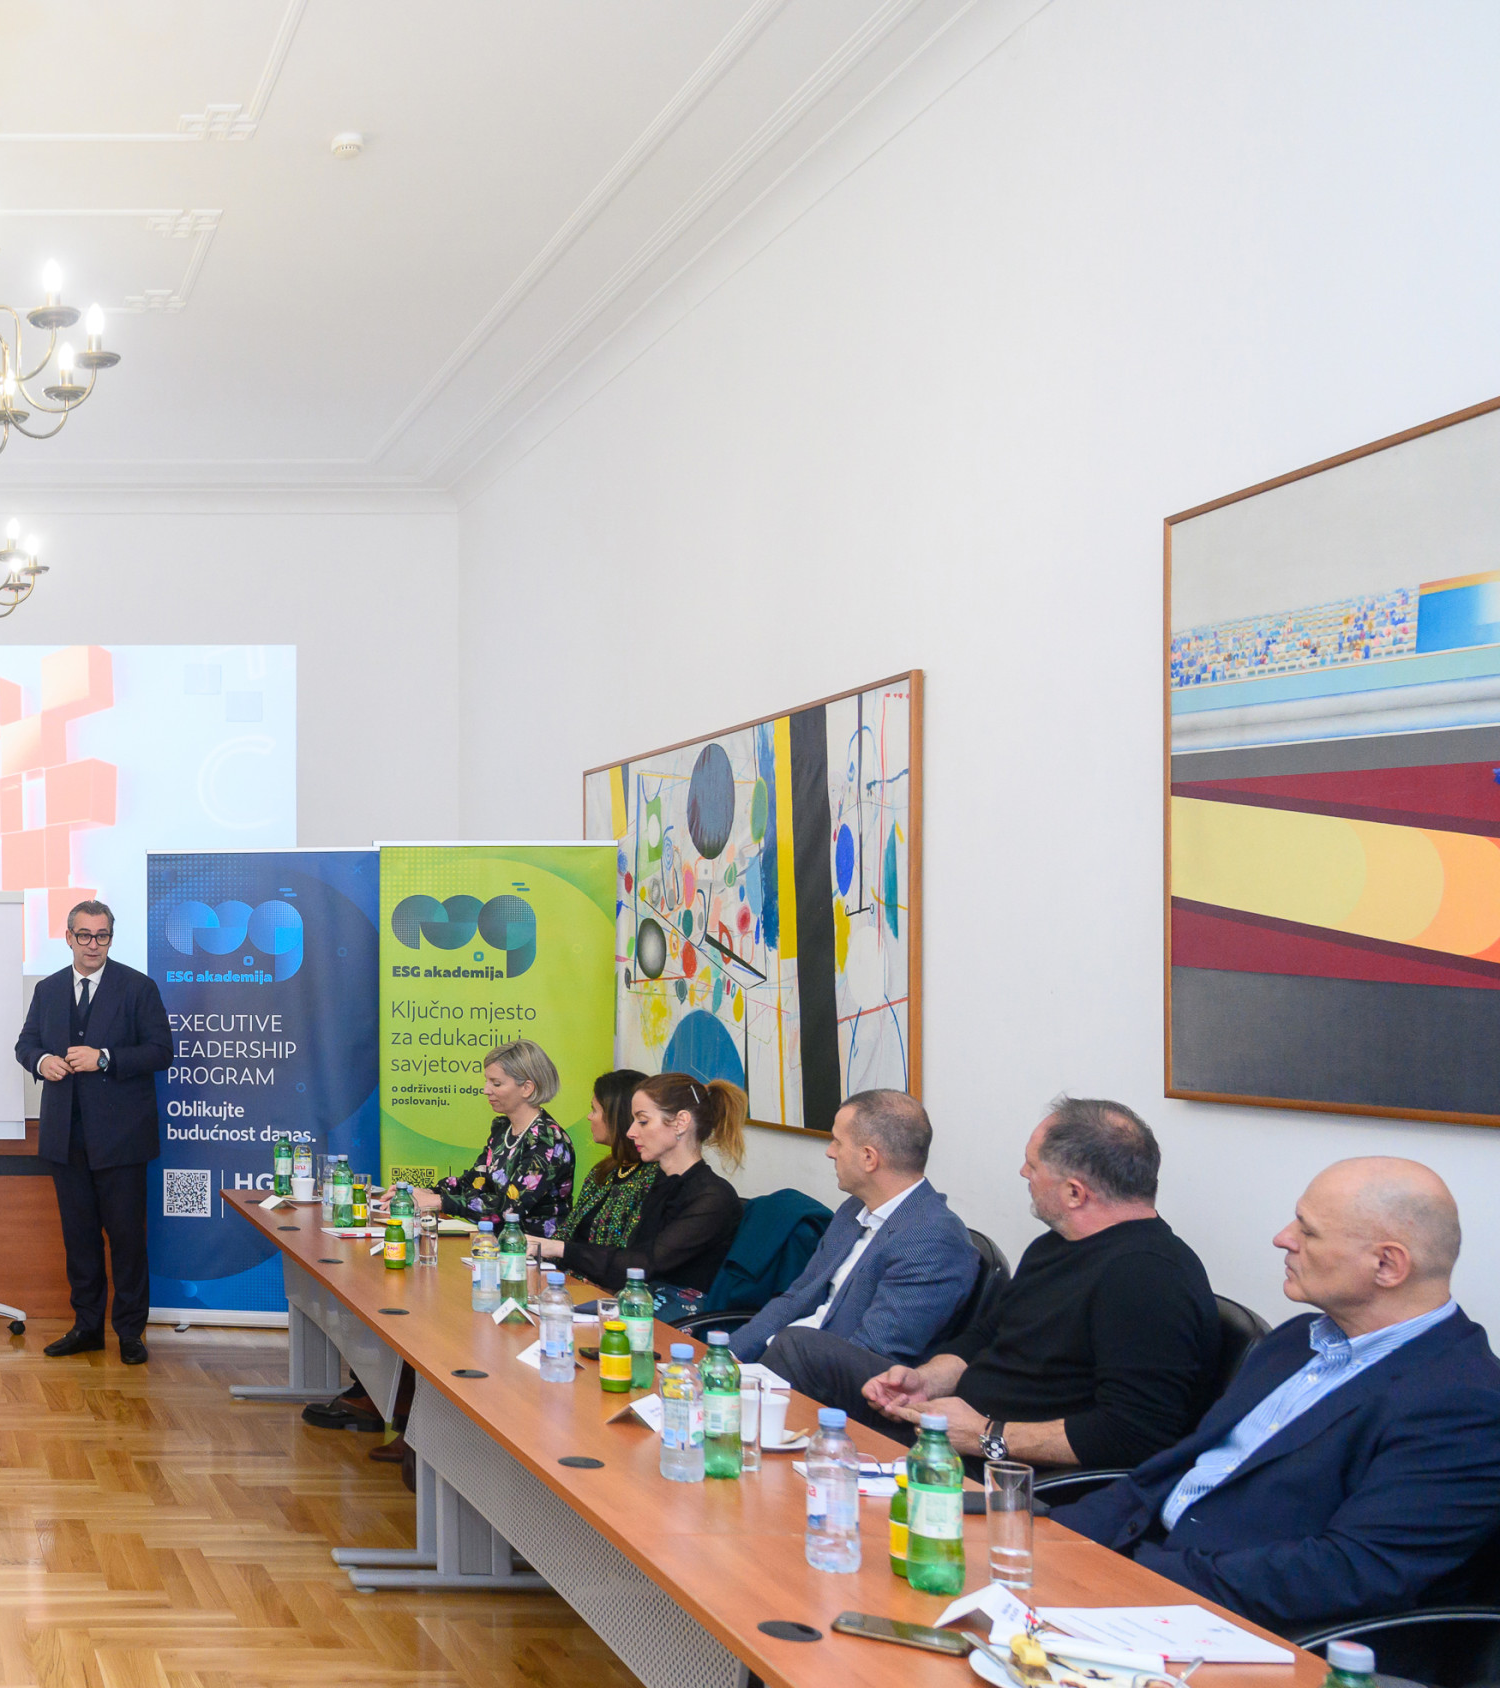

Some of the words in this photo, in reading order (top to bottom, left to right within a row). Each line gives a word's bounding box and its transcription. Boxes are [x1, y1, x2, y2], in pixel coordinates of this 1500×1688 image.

[166, 970, 194, 982] ESG
[196, 970, 273, 985] akademija
[392, 965, 420, 978] ESG
[424, 966, 504, 981] akademija
[391, 1000, 464, 1023] Ključno
[470, 1002, 537, 1024] mjesto
[168, 1014, 282, 1032] EXECUTIVE
[391, 1031, 412, 1045] za
[418, 1028, 511, 1047] edukaciju
[390, 1054, 483, 1076] savjetova
[167, 1067, 275, 1085] PROGRAM
[400, 1084, 451, 1094] održivosti
[453, 1084, 457, 1094] i
[459, 1085, 484, 1096] odgo
[166, 1100, 245, 1121] Oblikujte
[391, 1096, 451, 1107] poslovanju.
[167, 1124, 256, 1141] budućnost
[260, 1125, 317, 1143] danas.
